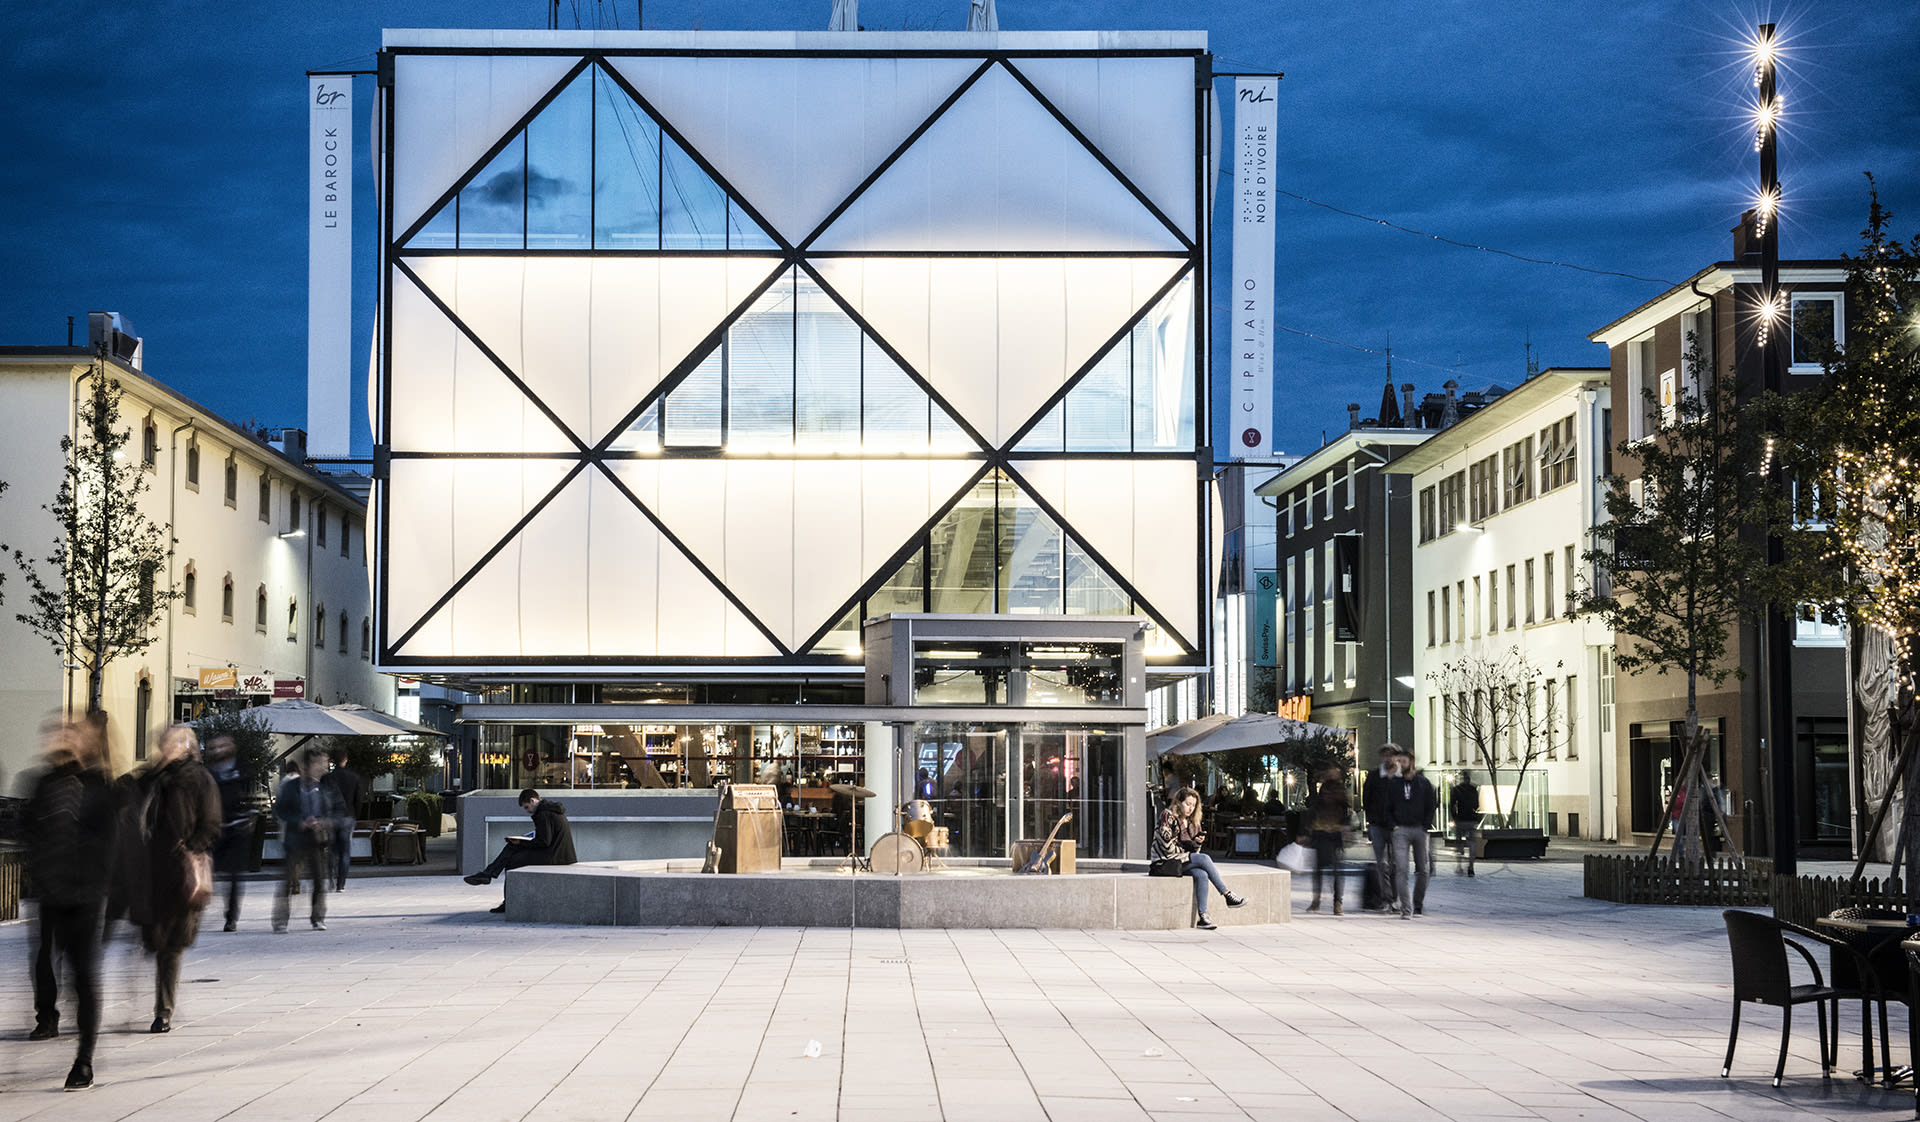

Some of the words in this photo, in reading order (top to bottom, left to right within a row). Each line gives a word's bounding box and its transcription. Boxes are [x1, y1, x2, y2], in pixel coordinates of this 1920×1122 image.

[325, 128, 337, 202] BAROCK
[1257, 126, 1267, 185] D'IVOIRE
[325, 210, 337, 228] LE
[1256, 190, 1267, 223] NOIR
[1243, 279, 1256, 412] CIPRIANO
